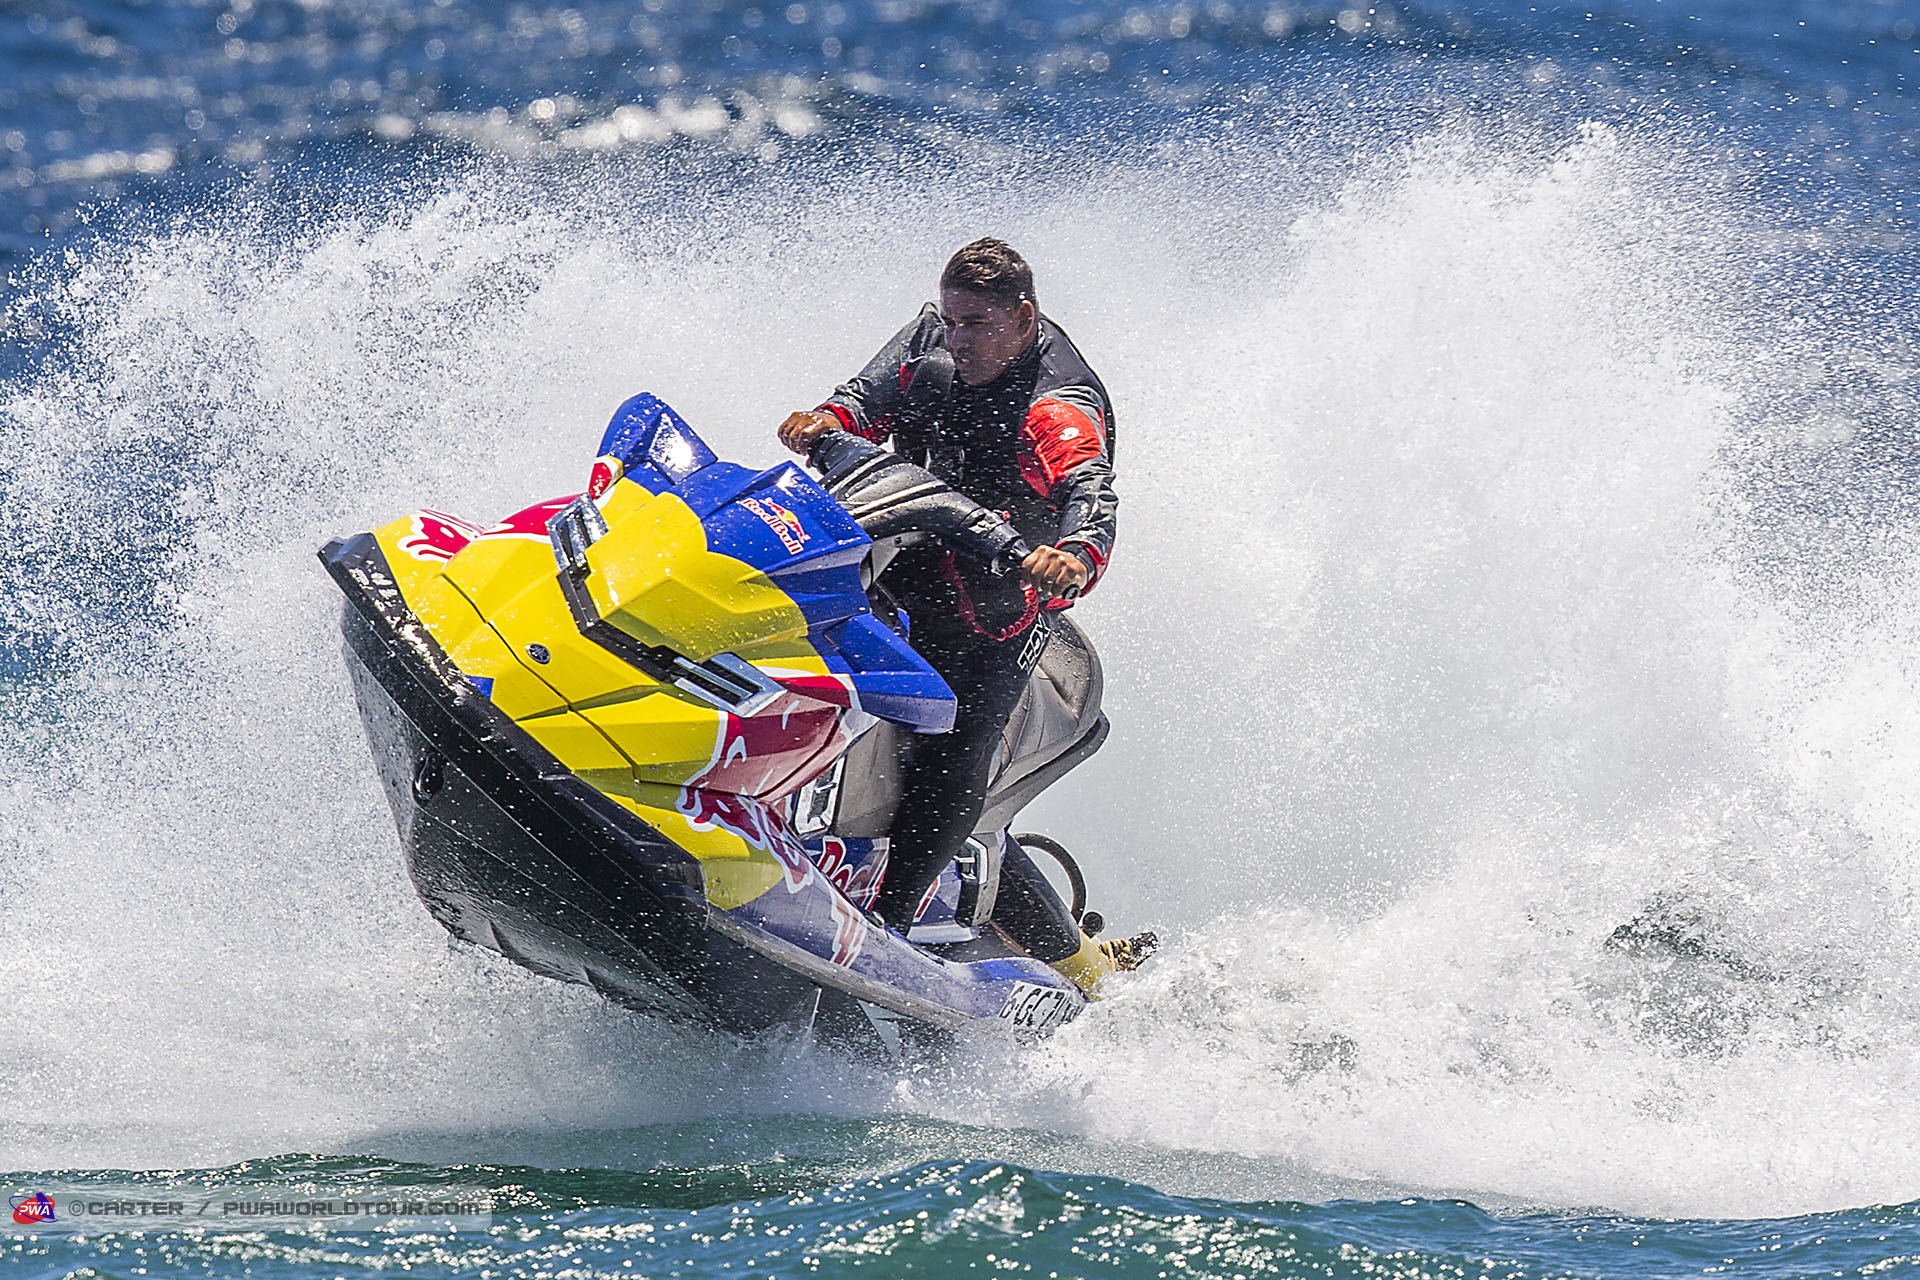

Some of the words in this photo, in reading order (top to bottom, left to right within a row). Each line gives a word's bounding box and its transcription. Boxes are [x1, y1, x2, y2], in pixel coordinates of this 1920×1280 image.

[741, 498, 779, 524] Red
[770, 521, 804, 555] Bull
[1016, 612, 1051, 675] XCEL
